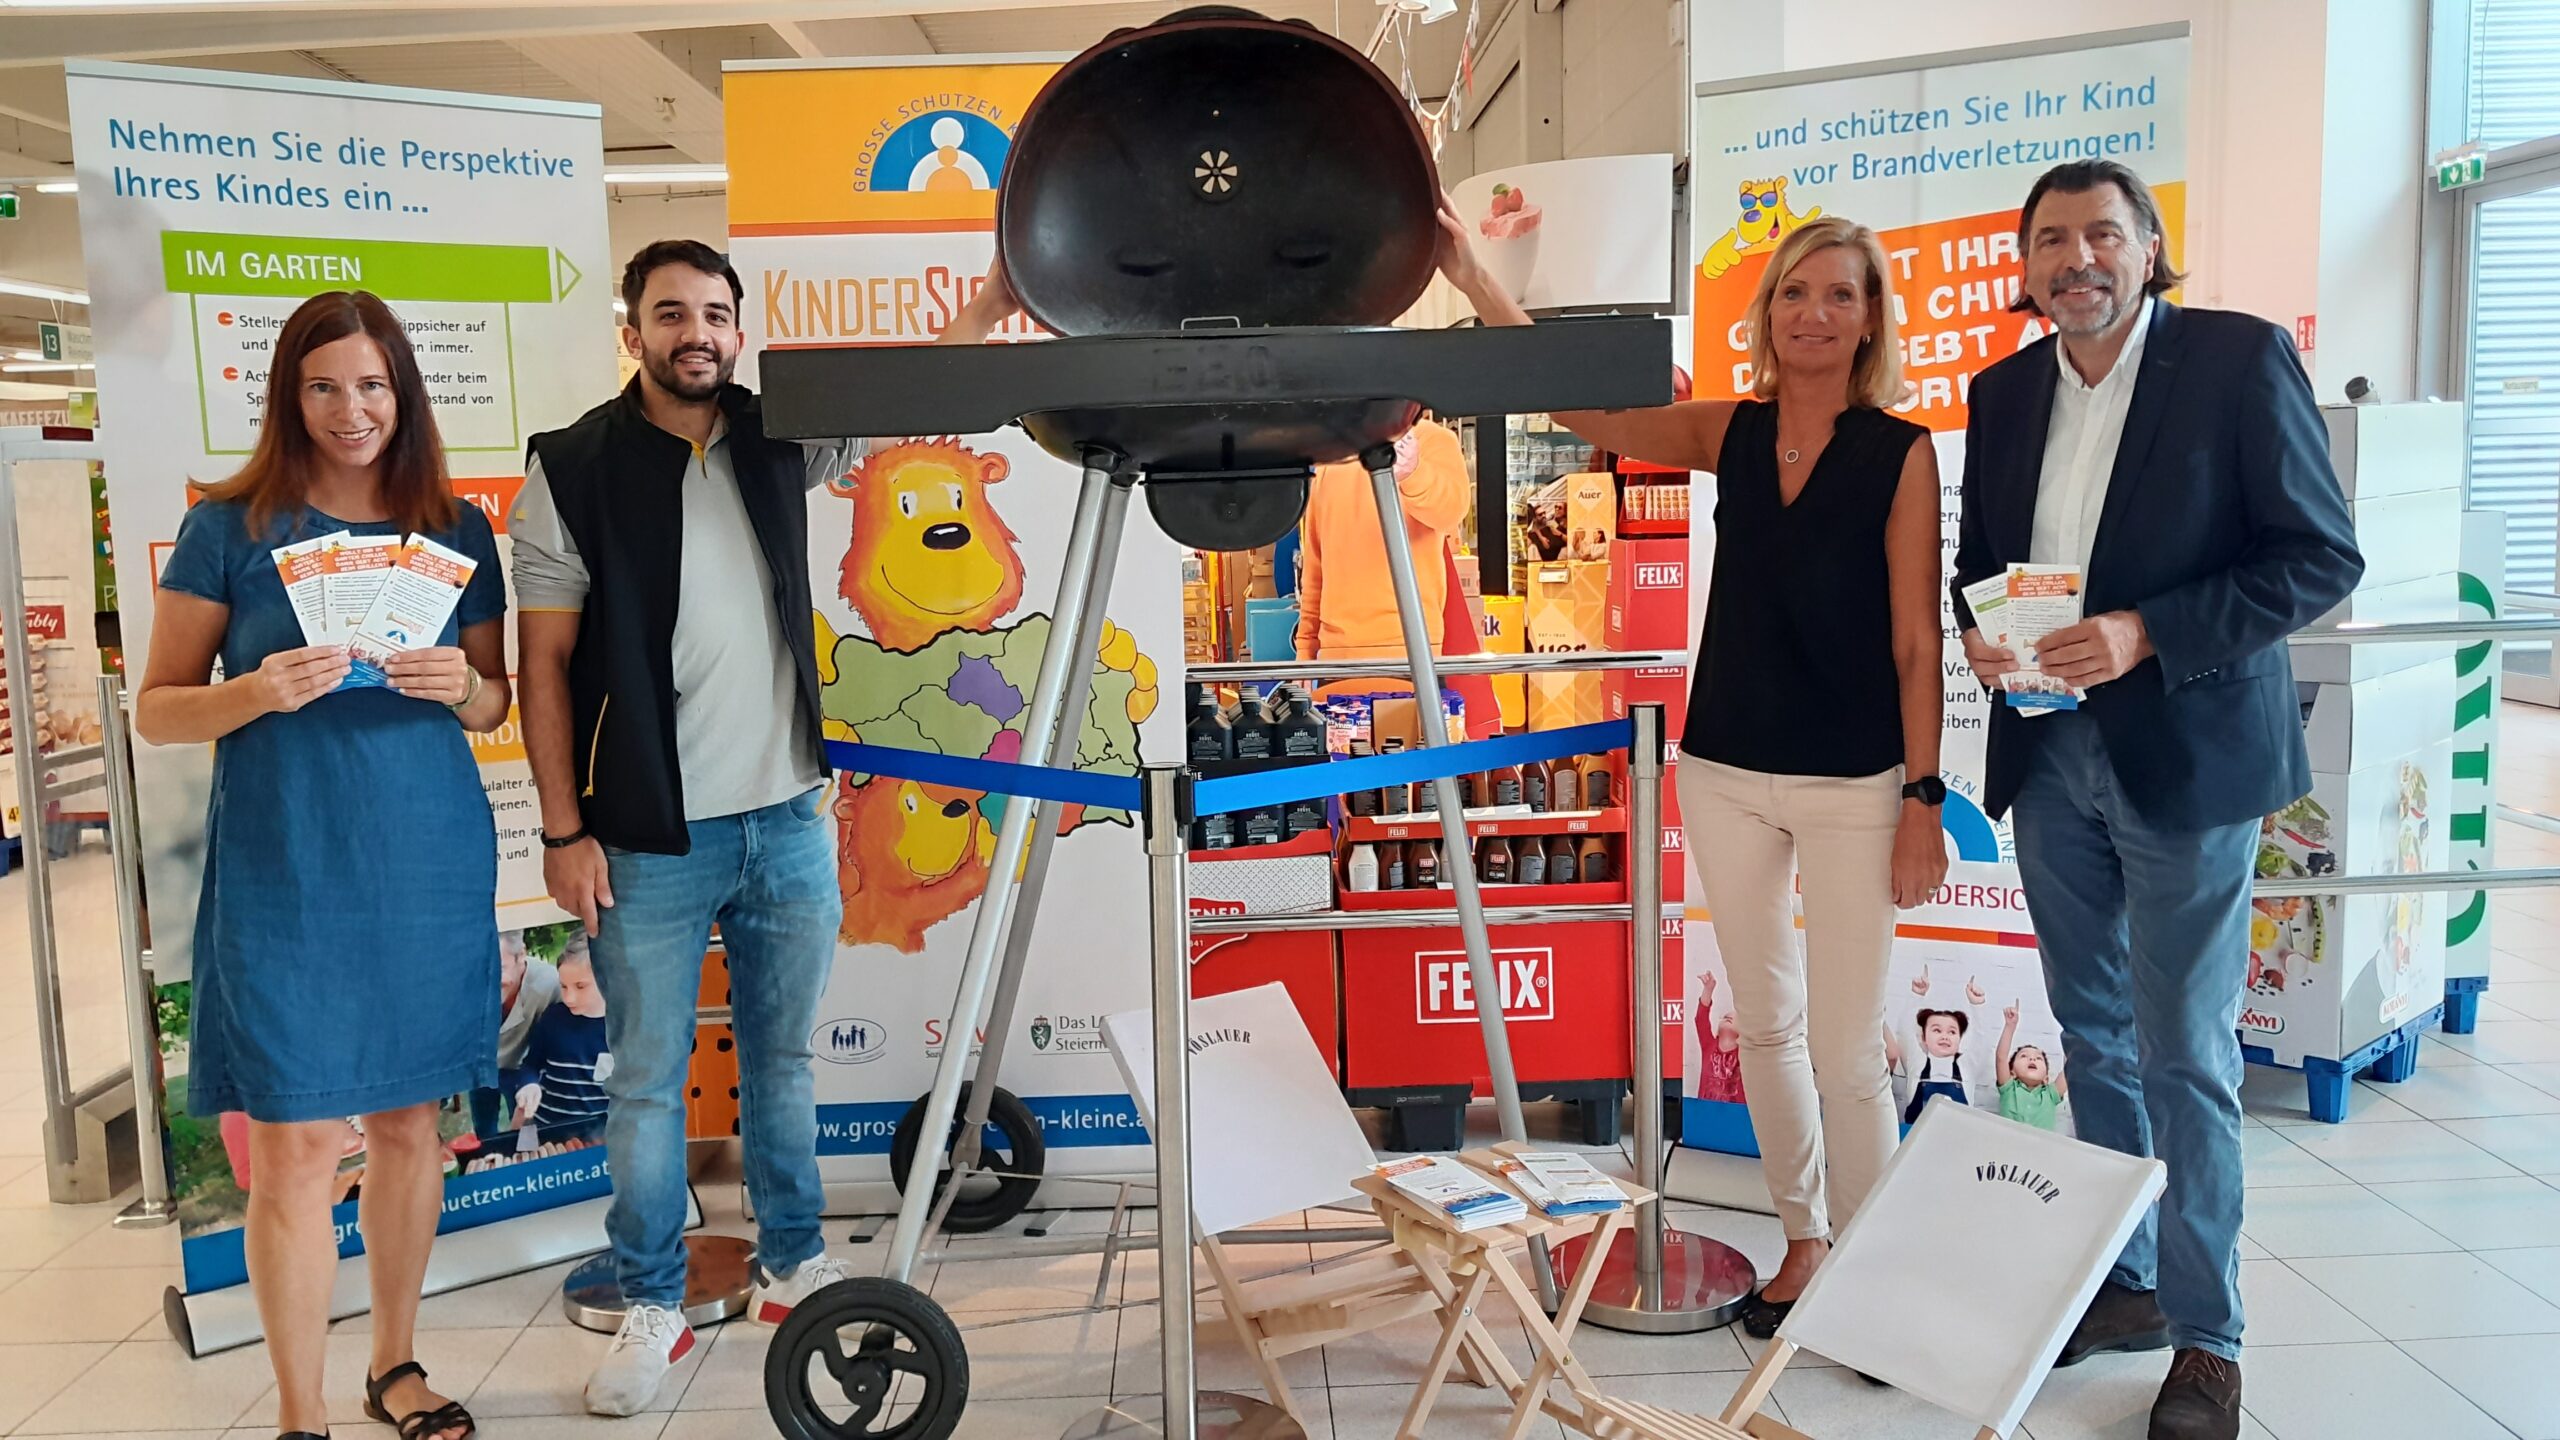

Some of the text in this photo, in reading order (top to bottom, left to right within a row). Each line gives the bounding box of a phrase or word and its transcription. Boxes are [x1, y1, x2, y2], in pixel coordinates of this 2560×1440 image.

[1756, 118, 1808, 150] und
[1820, 104, 1950, 143] schützen
[1964, 96, 2010, 127] Sie
[2025, 89, 2068, 119] Ihr
[2082, 76, 2156, 112] Kind
[108, 117, 575, 181] Nehmen Sie die Perspektive
[853, 93, 1003, 192] GROSSE SCHÜTZEN
[1793, 121, 2156, 187] vor Brandverletzungen!
[113, 166, 201, 201] Ihres
[217, 173, 330, 209] Kindes
[344, 182, 393, 212] ein
[1941, 232, 2020, 274] IHR
[184, 249, 362, 282] IM GARTEN
[400, 318, 487, 334] ippsicher auf
[44, 334, 58, 352] 13
[241, 338, 268, 351] und
[429, 341, 474, 353] immer.
[420, 370, 452, 385] inder
[457, 371, 488, 384] beim
[428, 393, 466, 406] stand
[471, 394, 494, 405] von
[1577, 490, 1602, 501] Auer
[1638, 566, 1681, 585] FELIX
[1945, 687, 1978, 704] und
[506, 847, 529, 860] und
[1059, 1016, 1087, 1030] Das
[2239, 1007, 2277, 1030] ÁNYI
[1055, 1037, 1104, 1051] Steierm
[1976, 1160, 2061, 1204] VÖSLAUER
